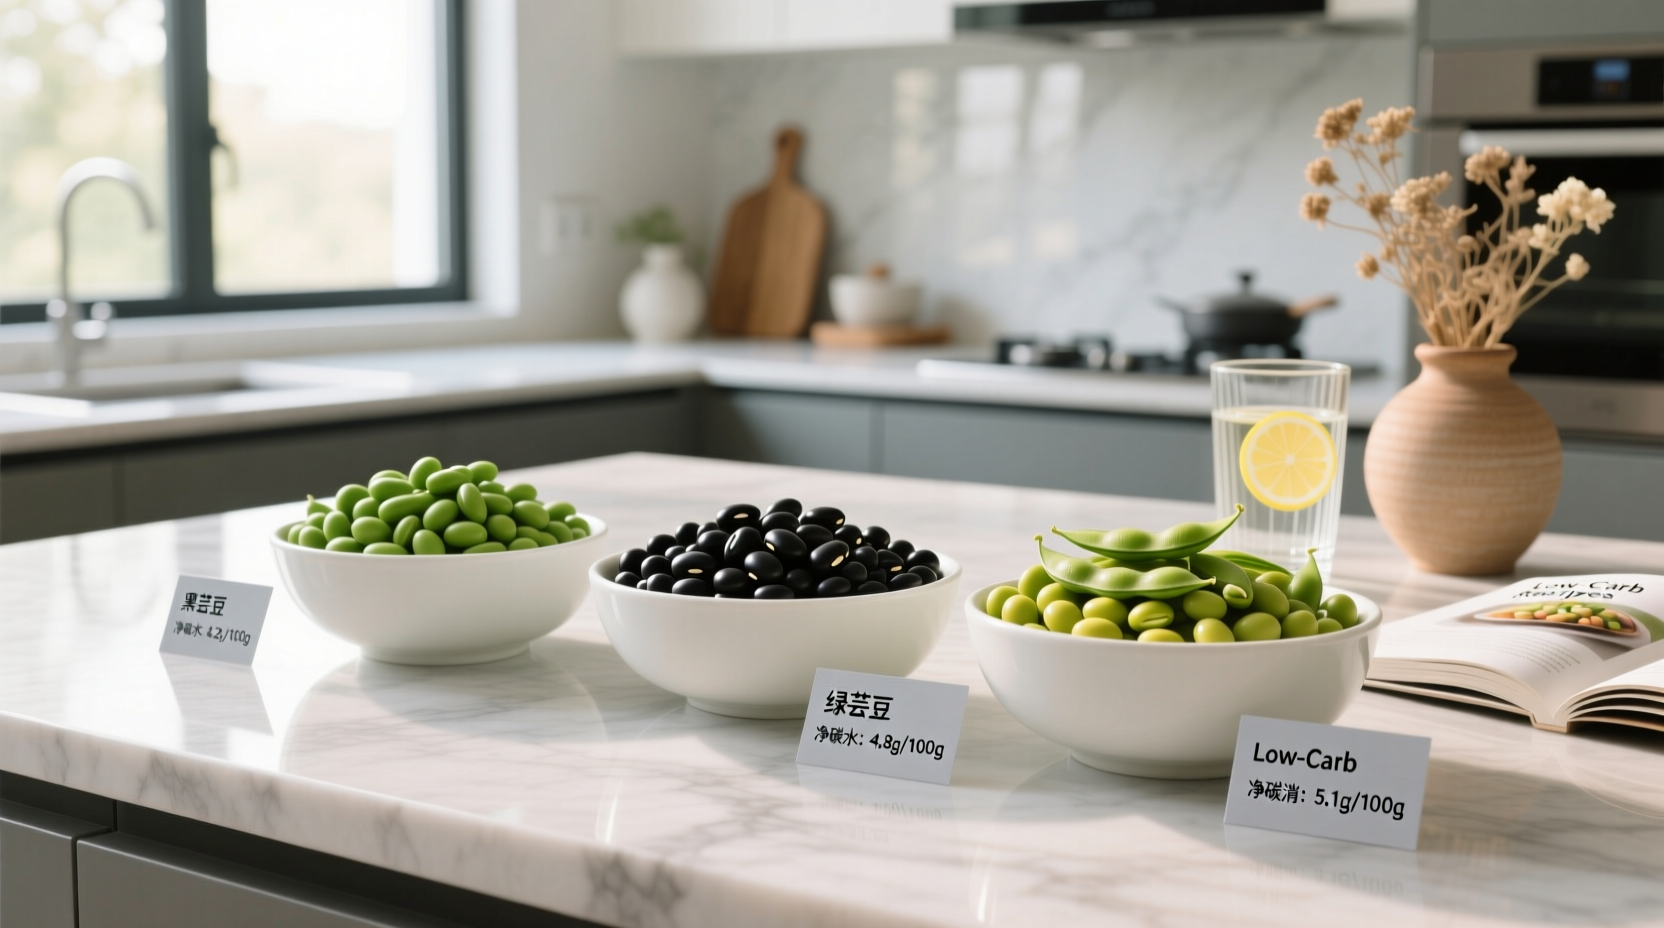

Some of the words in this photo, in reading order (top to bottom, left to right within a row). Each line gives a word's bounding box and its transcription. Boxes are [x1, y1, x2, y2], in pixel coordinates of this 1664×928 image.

[824, 689, 894, 721] 绿芸豆
[869, 733, 945, 761] 4.8g/100g
[1253, 742, 1357, 773] Low-Carb
[1314, 788, 1405, 821] 5.1g/100g
